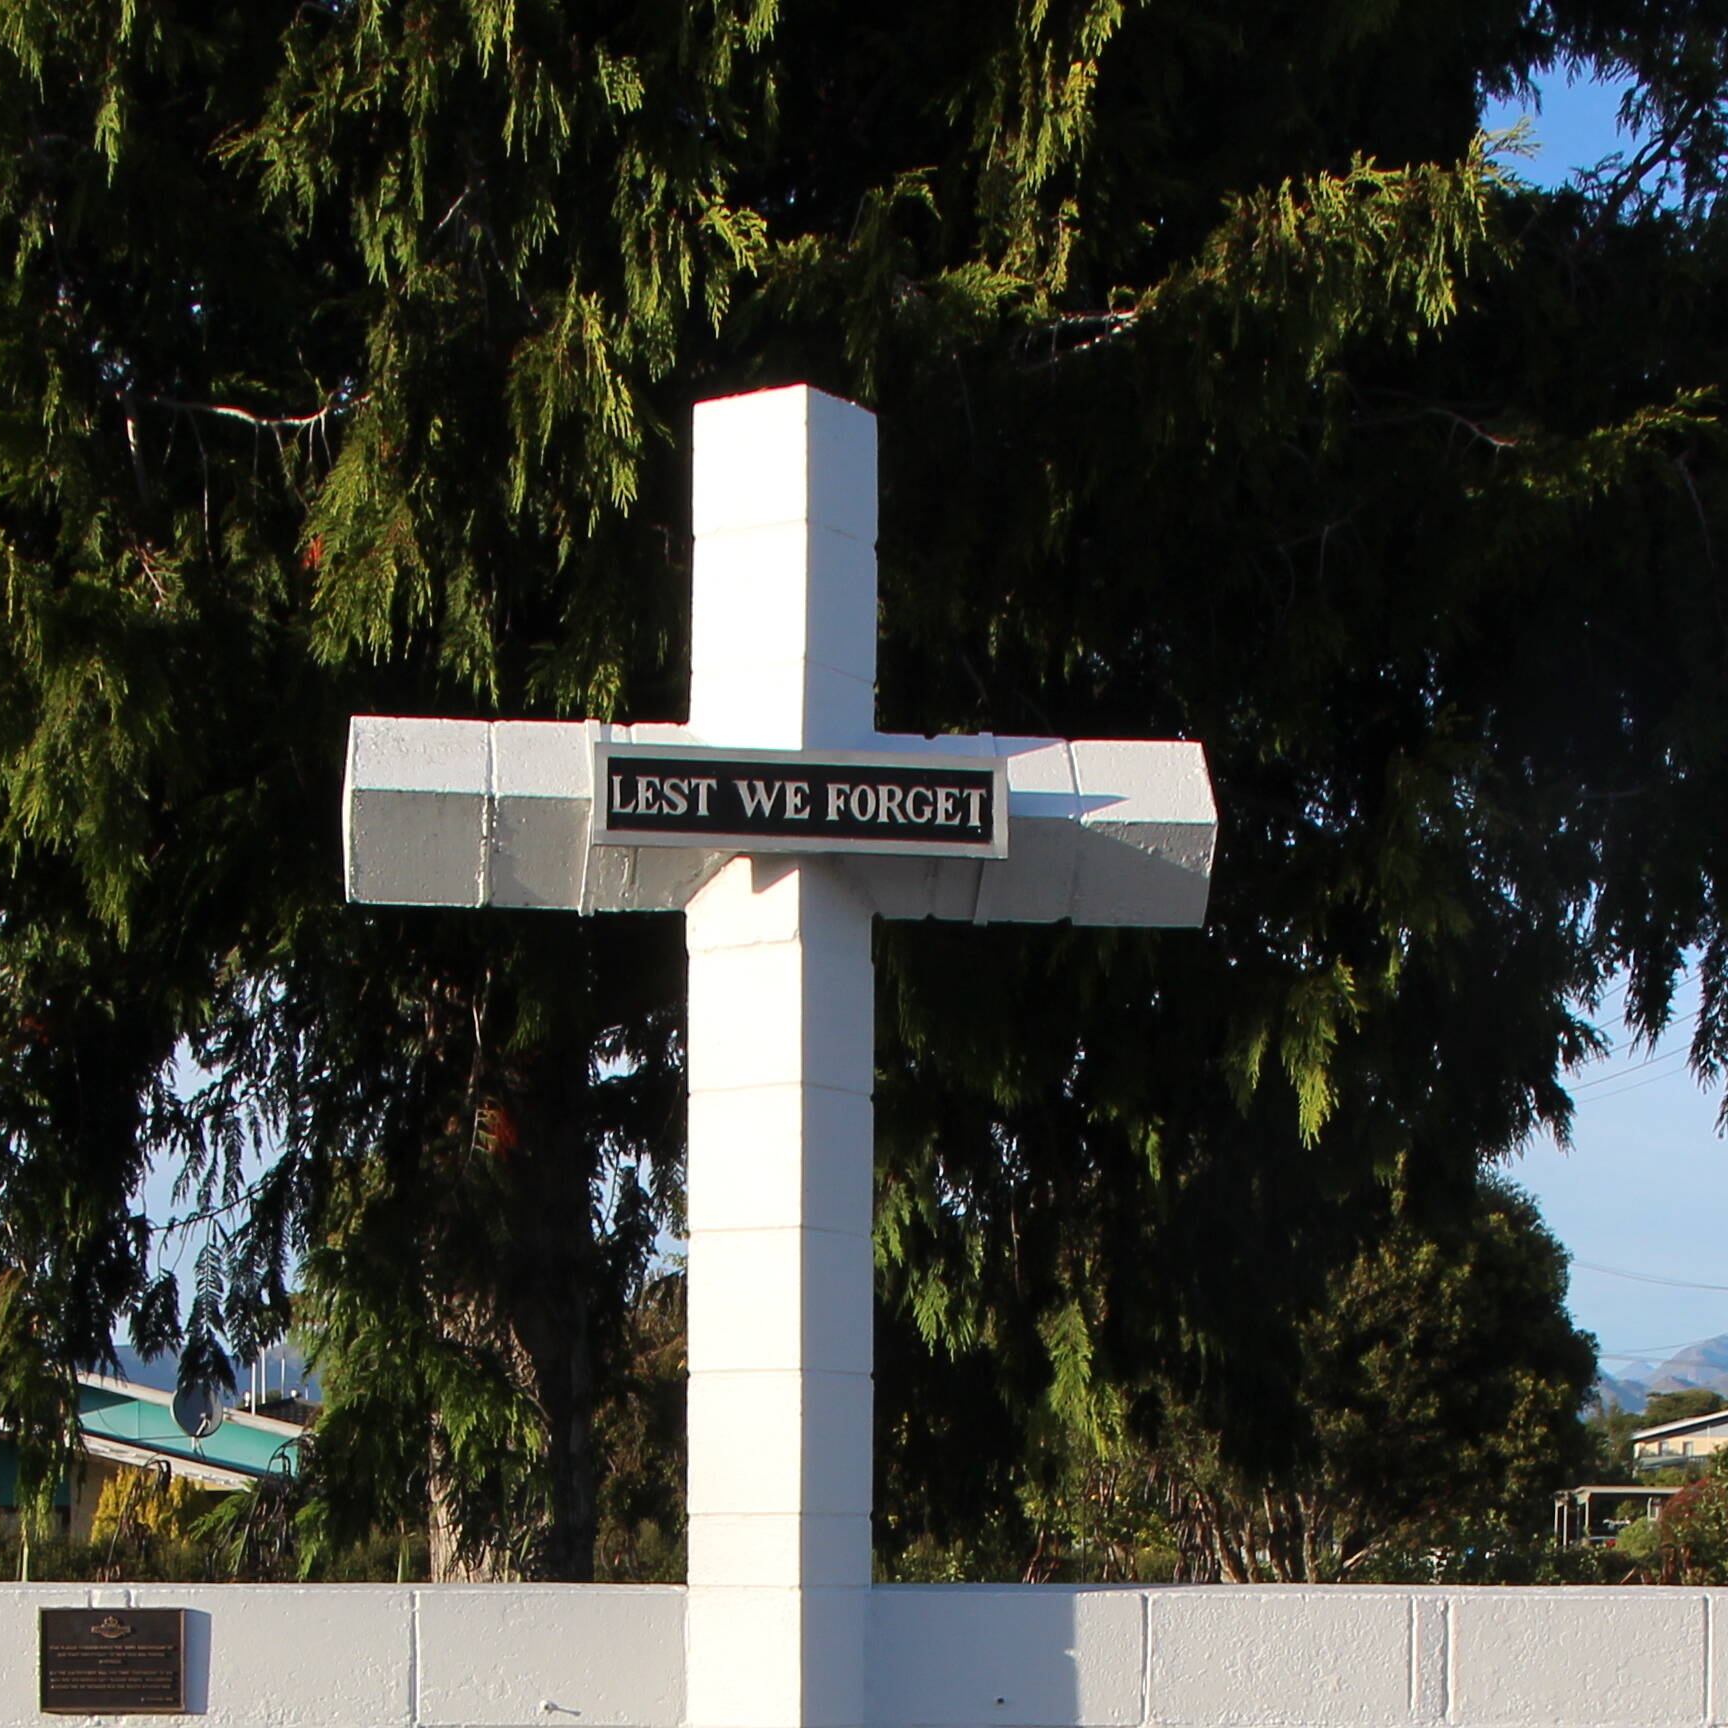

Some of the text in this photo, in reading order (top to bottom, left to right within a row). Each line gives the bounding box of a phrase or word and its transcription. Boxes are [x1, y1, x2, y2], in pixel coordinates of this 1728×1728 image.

[612, 775, 987, 827] LEST WE FORGET
